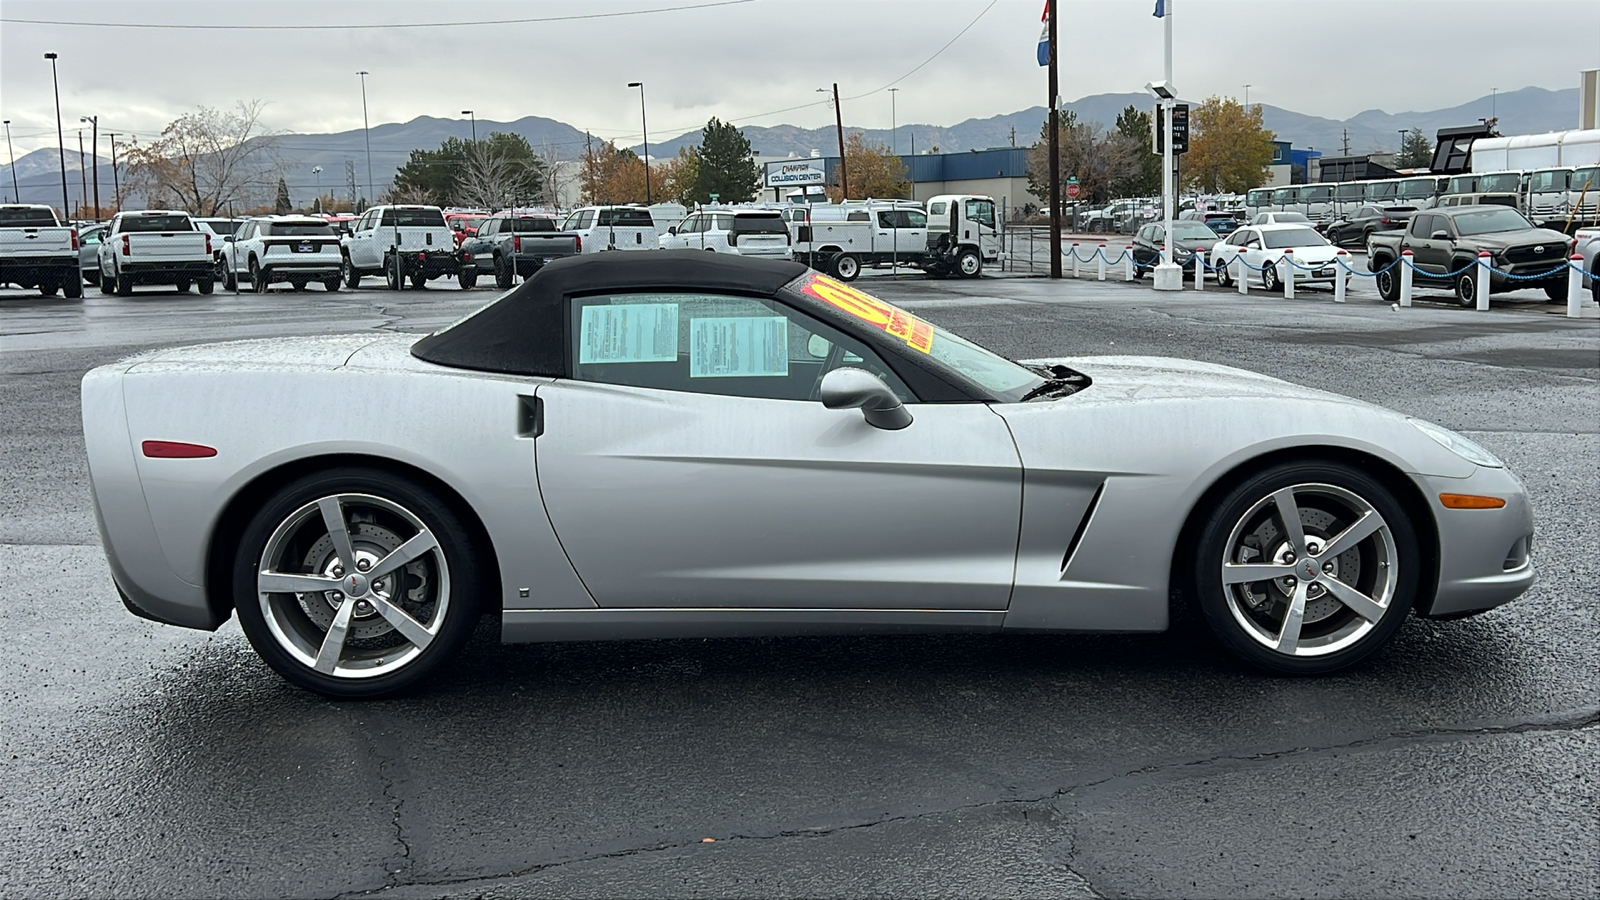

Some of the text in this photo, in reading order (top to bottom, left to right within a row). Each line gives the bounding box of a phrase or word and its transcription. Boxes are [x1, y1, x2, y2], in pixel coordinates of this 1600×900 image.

[782, 164, 809, 174] CHAMPION
[771, 173, 821, 182] COLLISION CENTER
